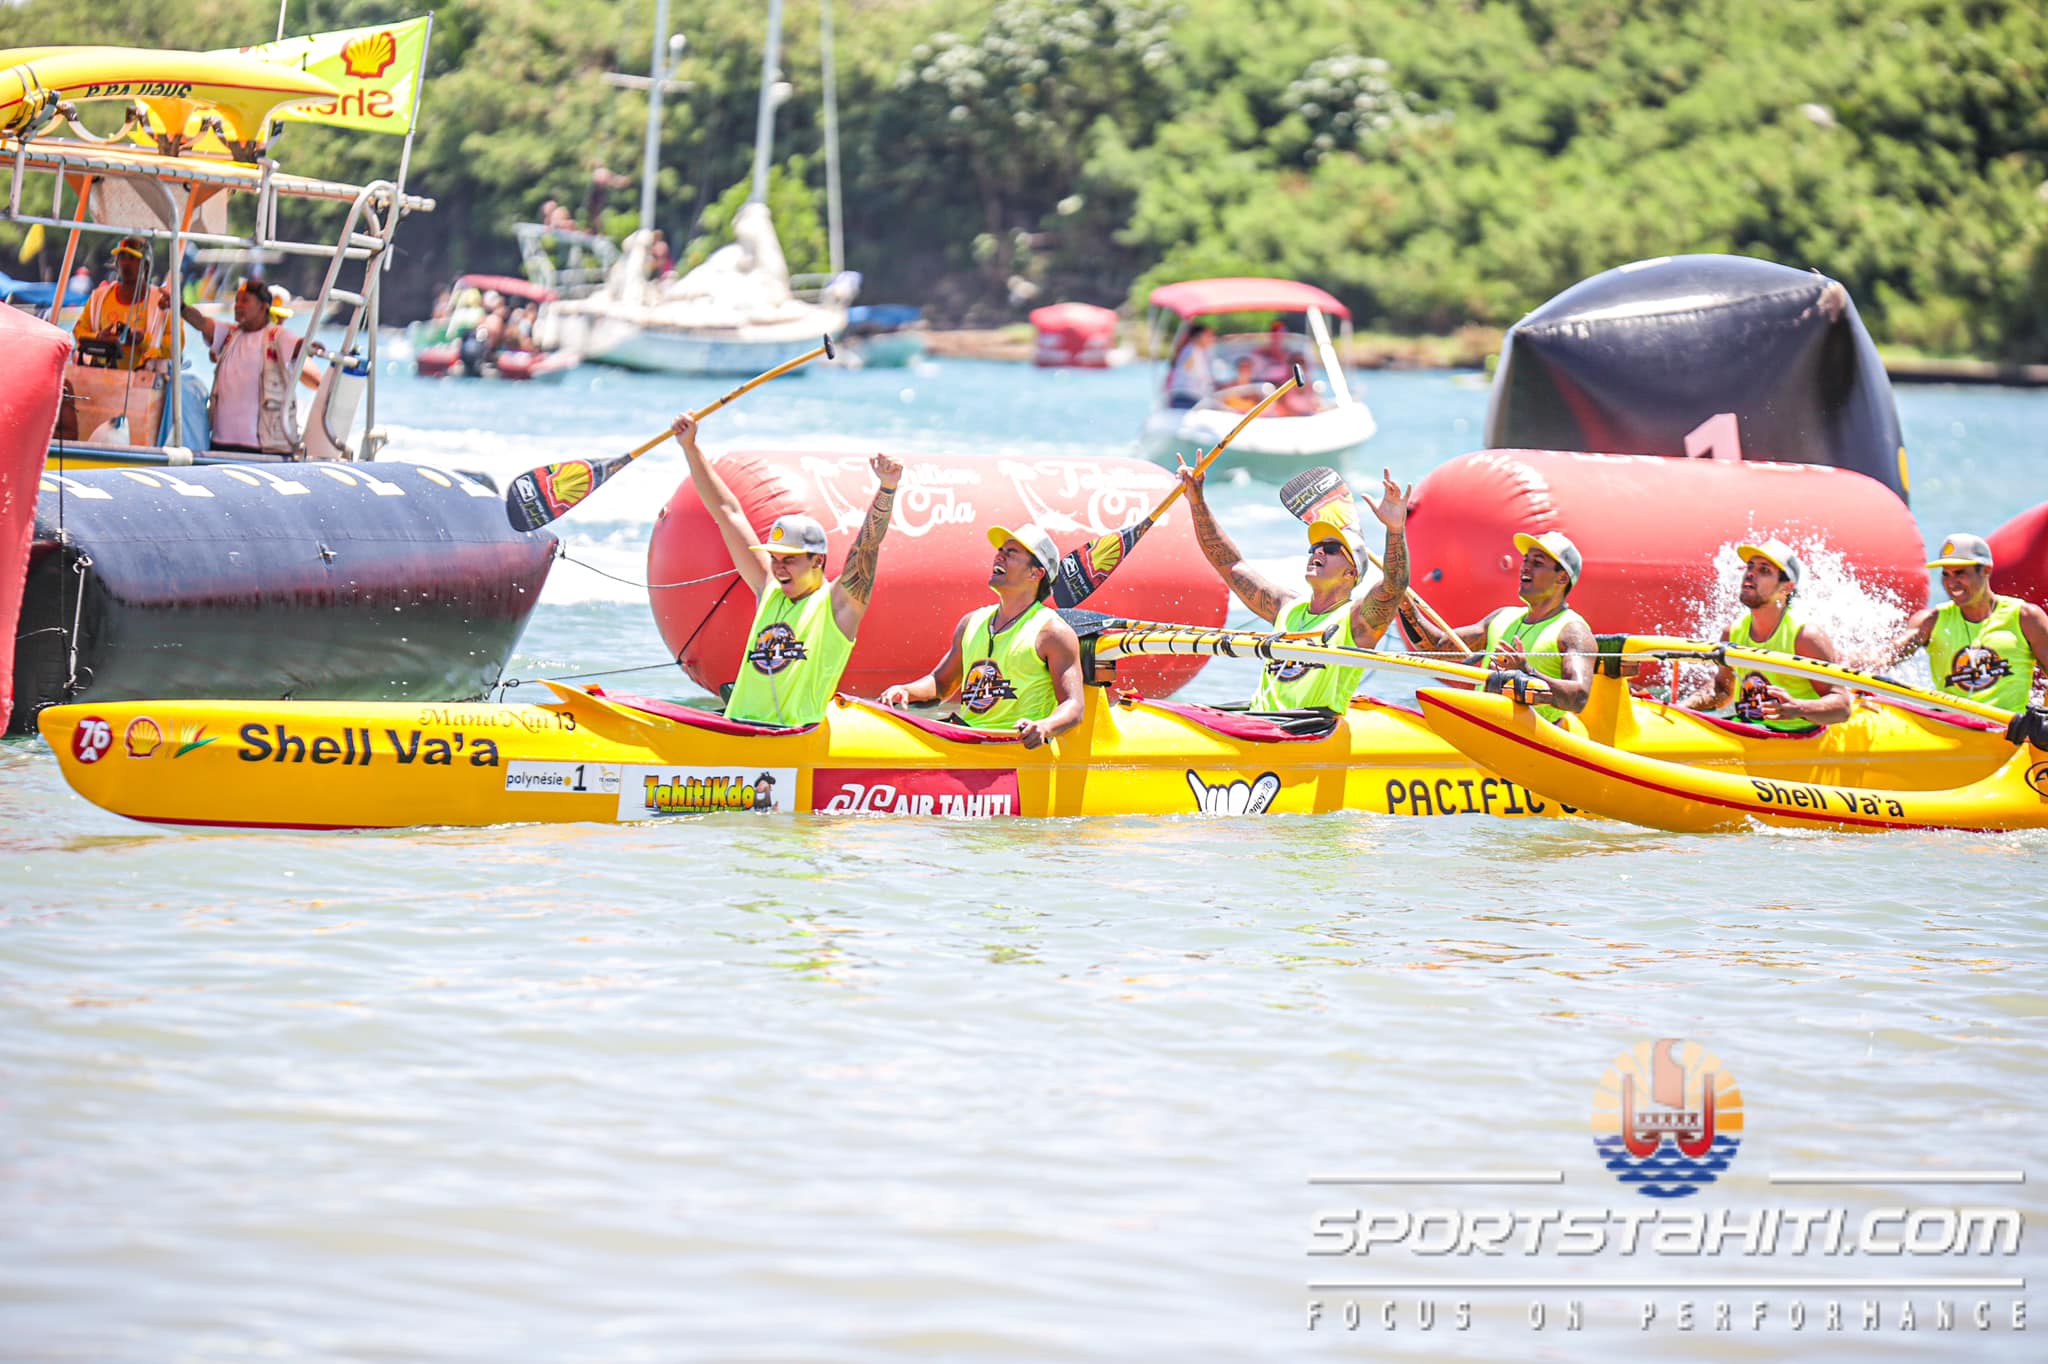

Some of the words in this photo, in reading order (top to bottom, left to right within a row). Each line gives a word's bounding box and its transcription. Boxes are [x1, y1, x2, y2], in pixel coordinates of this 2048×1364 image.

[891, 485, 977, 537] Cola
[79, 720, 111, 750] 76
[555, 711, 577, 732] 13
[79, 747, 99, 762] A
[238, 723, 373, 766] Shell
[385, 729, 500, 768] Va'a
[506, 771, 564, 789] polynésie
[572, 764, 588, 792] 1
[644, 774, 756, 809] TahitiKdo
[893, 794, 935, 817] AIR
[938, 794, 1013, 818] TAHITI
[1751, 780, 1829, 810] Shell
[1835, 790, 1905, 818] Va'a
